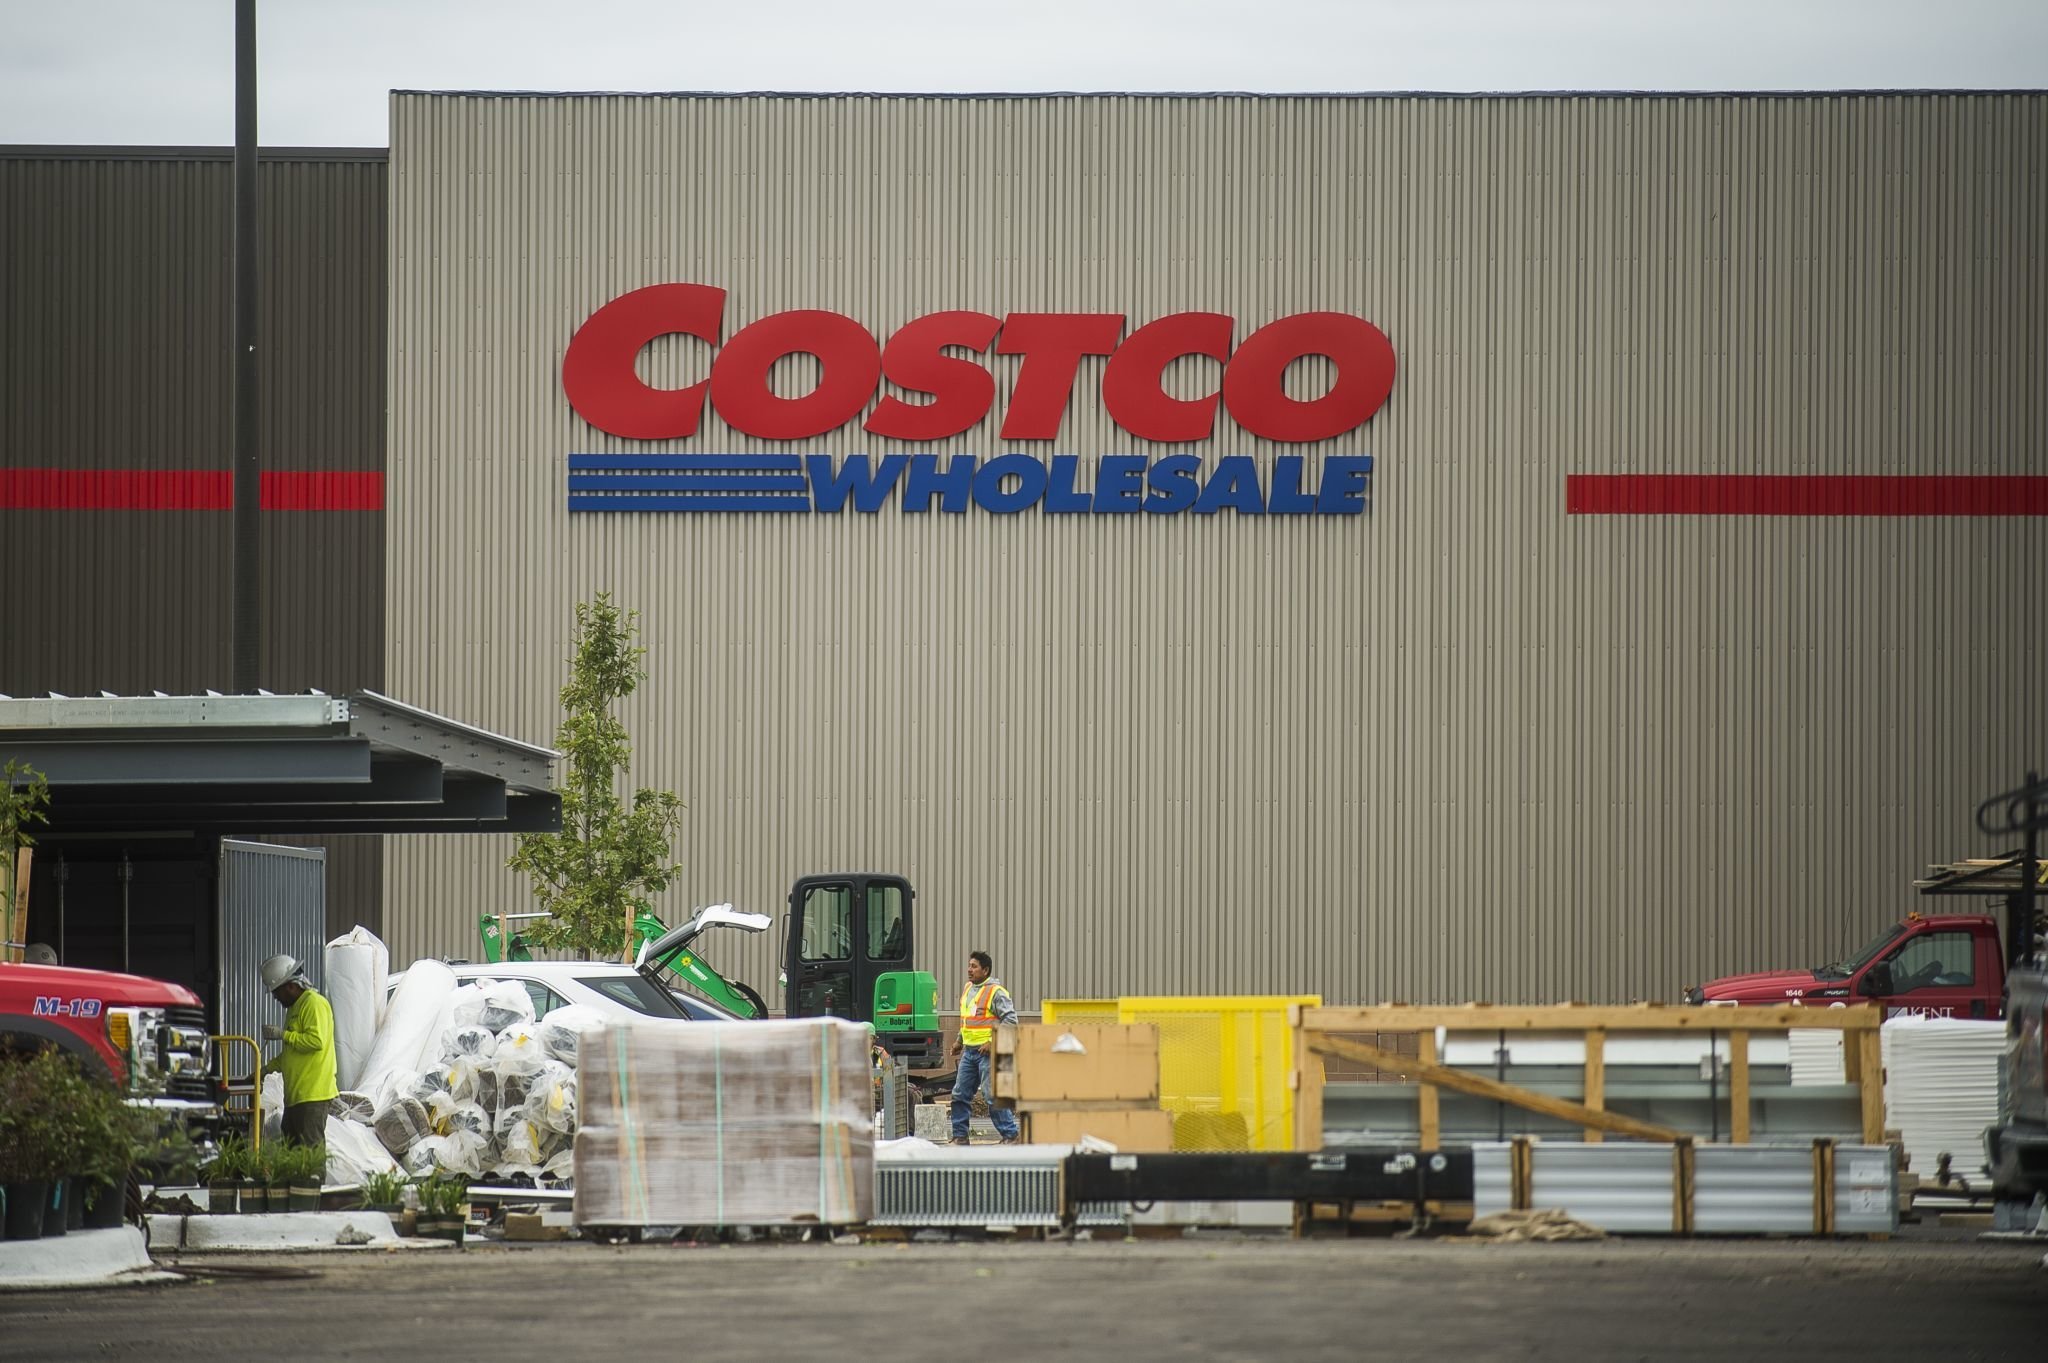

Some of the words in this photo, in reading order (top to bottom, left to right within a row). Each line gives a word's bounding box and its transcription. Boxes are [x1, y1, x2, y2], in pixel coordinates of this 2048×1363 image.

[563, 283, 1397, 442] COSTCO
[805, 453, 1373, 514] WHOLESALE
[1785, 989, 1803, 997] 1646
[33, 996, 101, 1018] M-19
[1910, 1006, 1955, 1020] KENT
[889, 1017, 912, 1025] Bobcat
